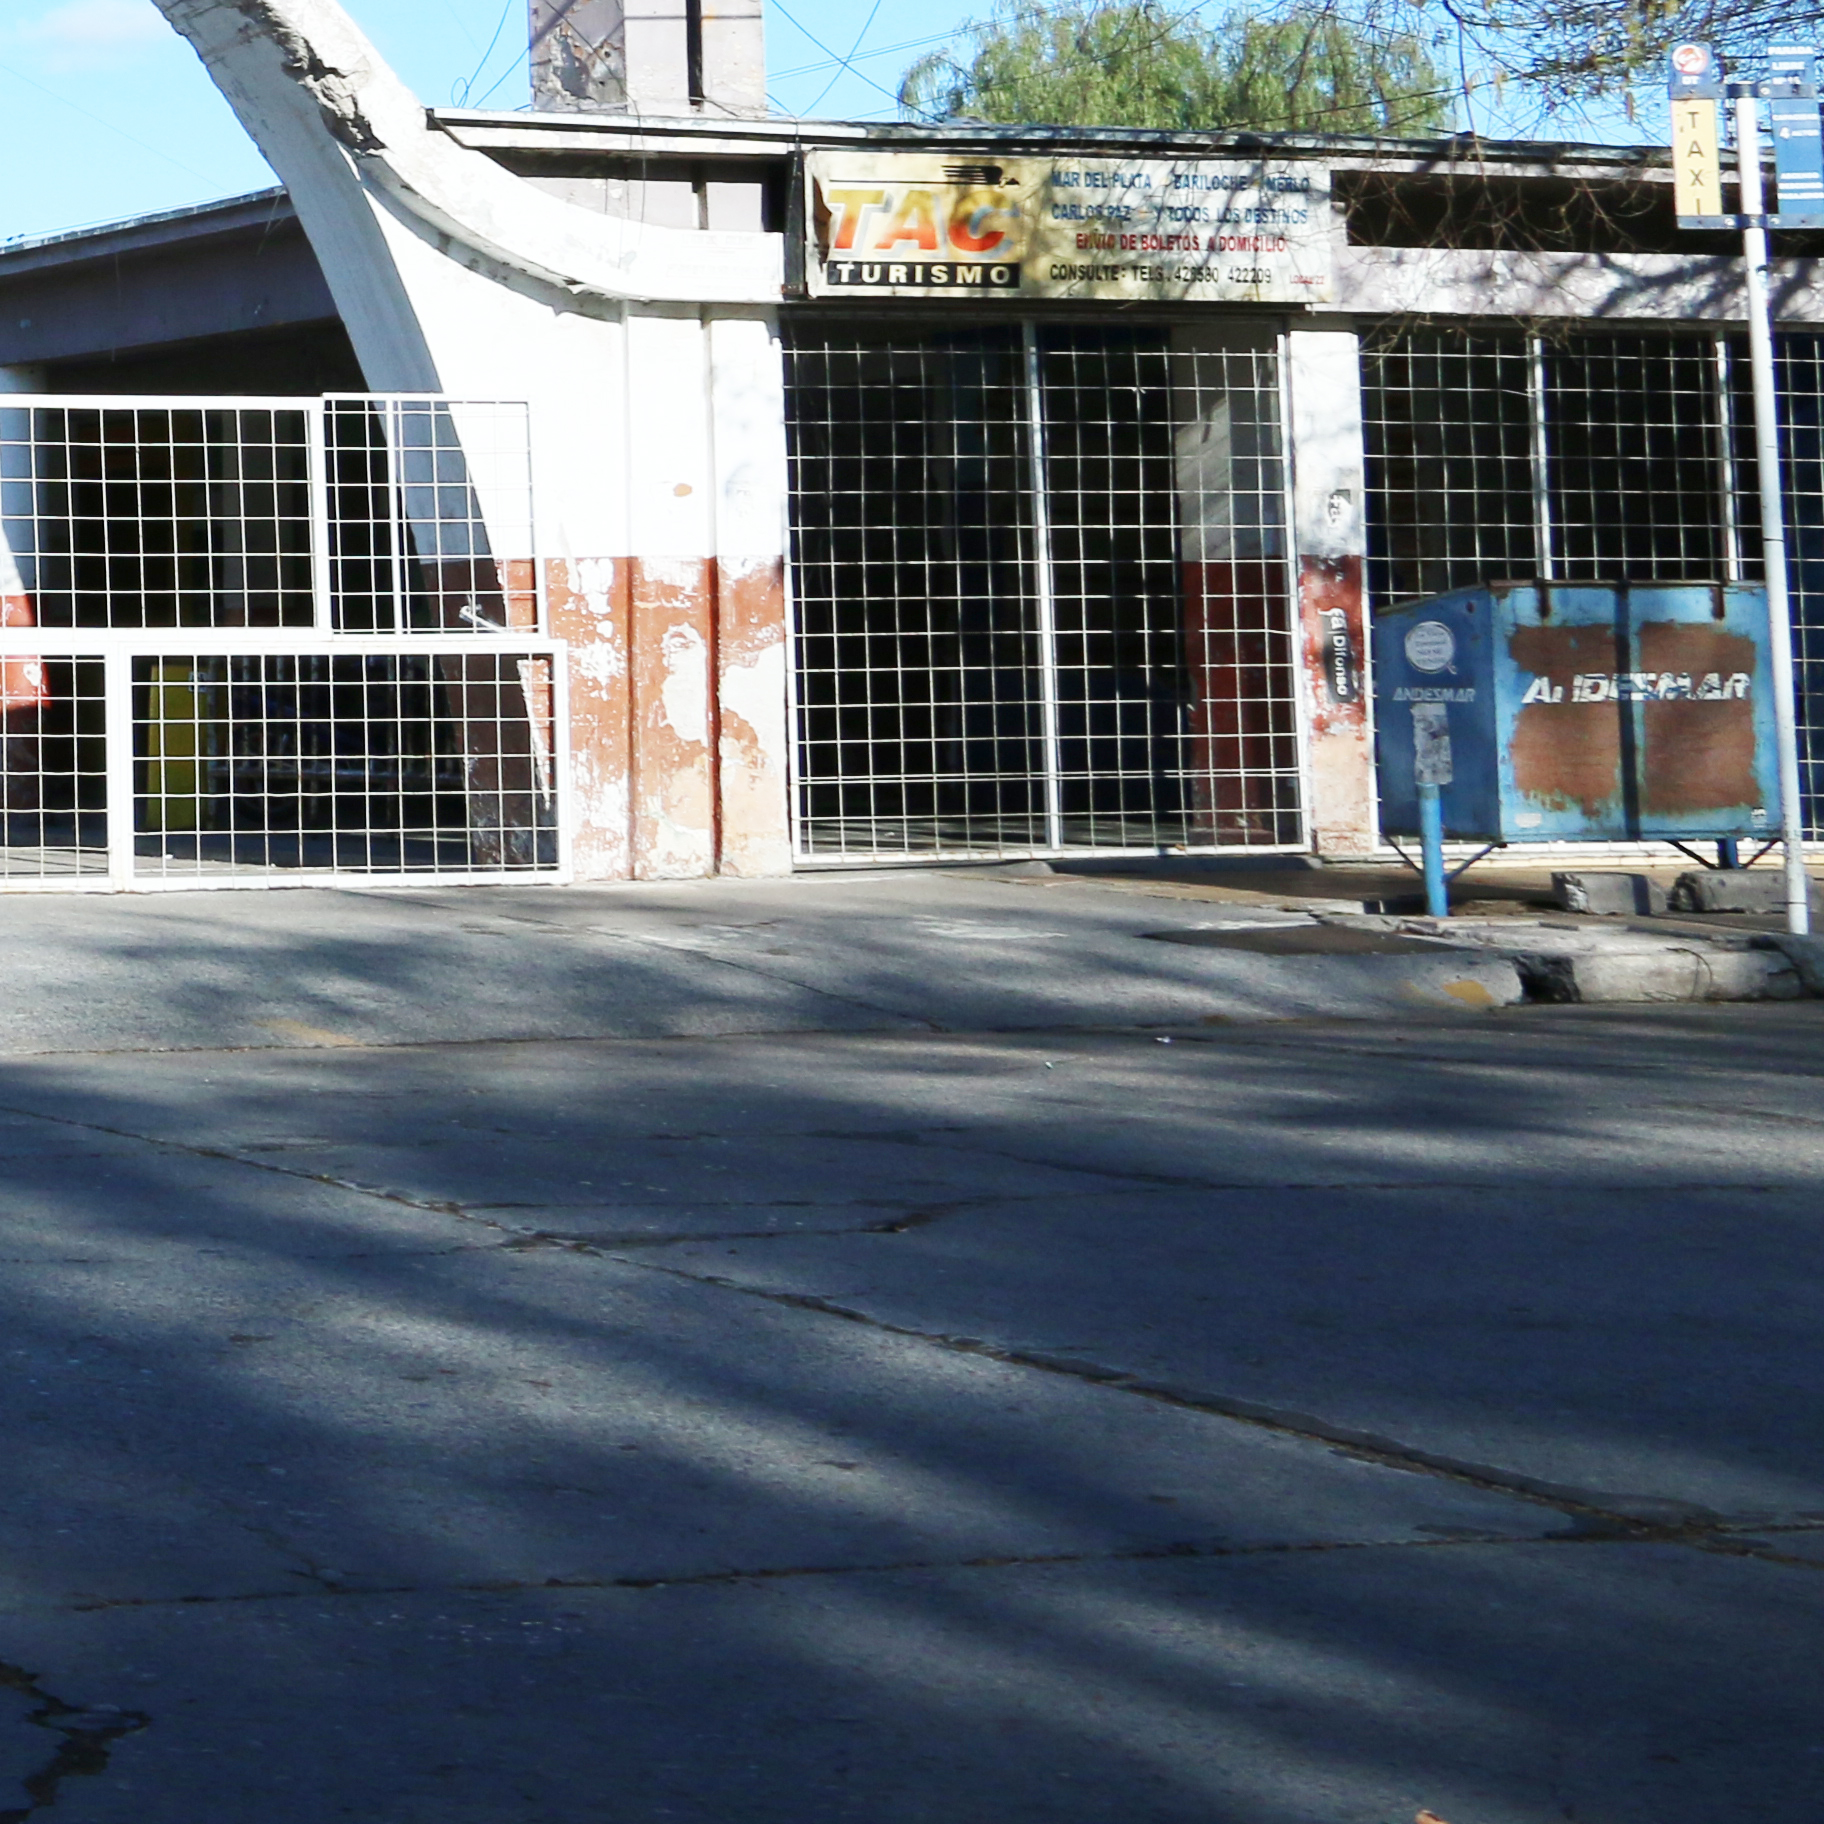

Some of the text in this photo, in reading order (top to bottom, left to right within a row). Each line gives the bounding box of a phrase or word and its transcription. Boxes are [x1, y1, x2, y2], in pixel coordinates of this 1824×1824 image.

[1687, 111, 1705, 215] TAXI
[1051, 172, 1080, 188] MAR
[1085, 172, 1108, 188] DEL
[1113, 172, 1152, 189] PLATA
[1174, 175, 1248, 191] BARILOCHE
[828, 189, 1016, 254] TAC
[1052, 203, 1102, 221] CARLOS
[1107, 205, 1132, 222] PAZ
[1217, 208, 1240, 224] LOS
[1245, 208, 1309, 224] DESTINOS
[1121, 234, 1137, 251] DE
[1141, 234, 1200, 252] BOLETOS
[1219, 236, 1287, 252] DOMICILIO
[836, 263, 1010, 285] TURISMO
[1392, 686, 1477, 703] ANDESMAR
